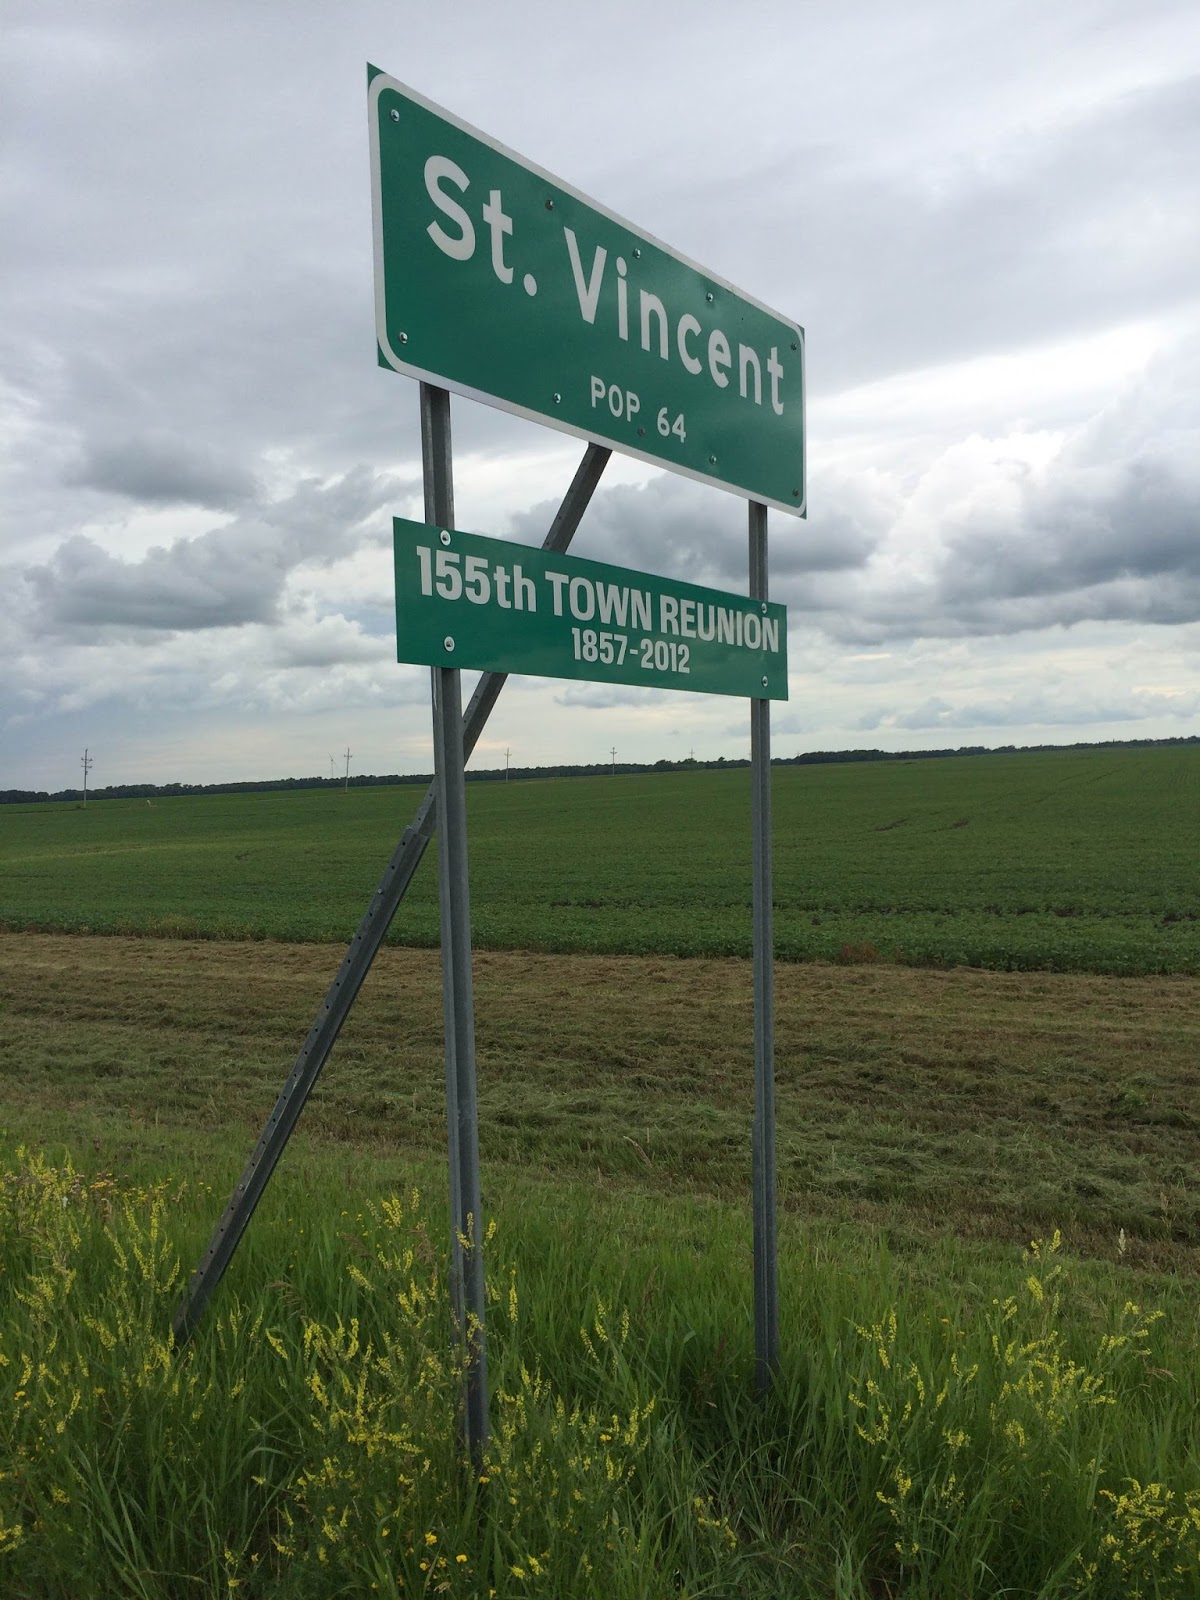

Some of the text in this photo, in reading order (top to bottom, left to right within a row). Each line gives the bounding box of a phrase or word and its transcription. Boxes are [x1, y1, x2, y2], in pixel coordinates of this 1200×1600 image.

[423, 155, 785, 416] St. Vincent
[590, 375, 687, 444] POP 64
[416, 545, 779, 653] 155th TOWN REUNION
[571, 627, 691, 674] 1857-2012
